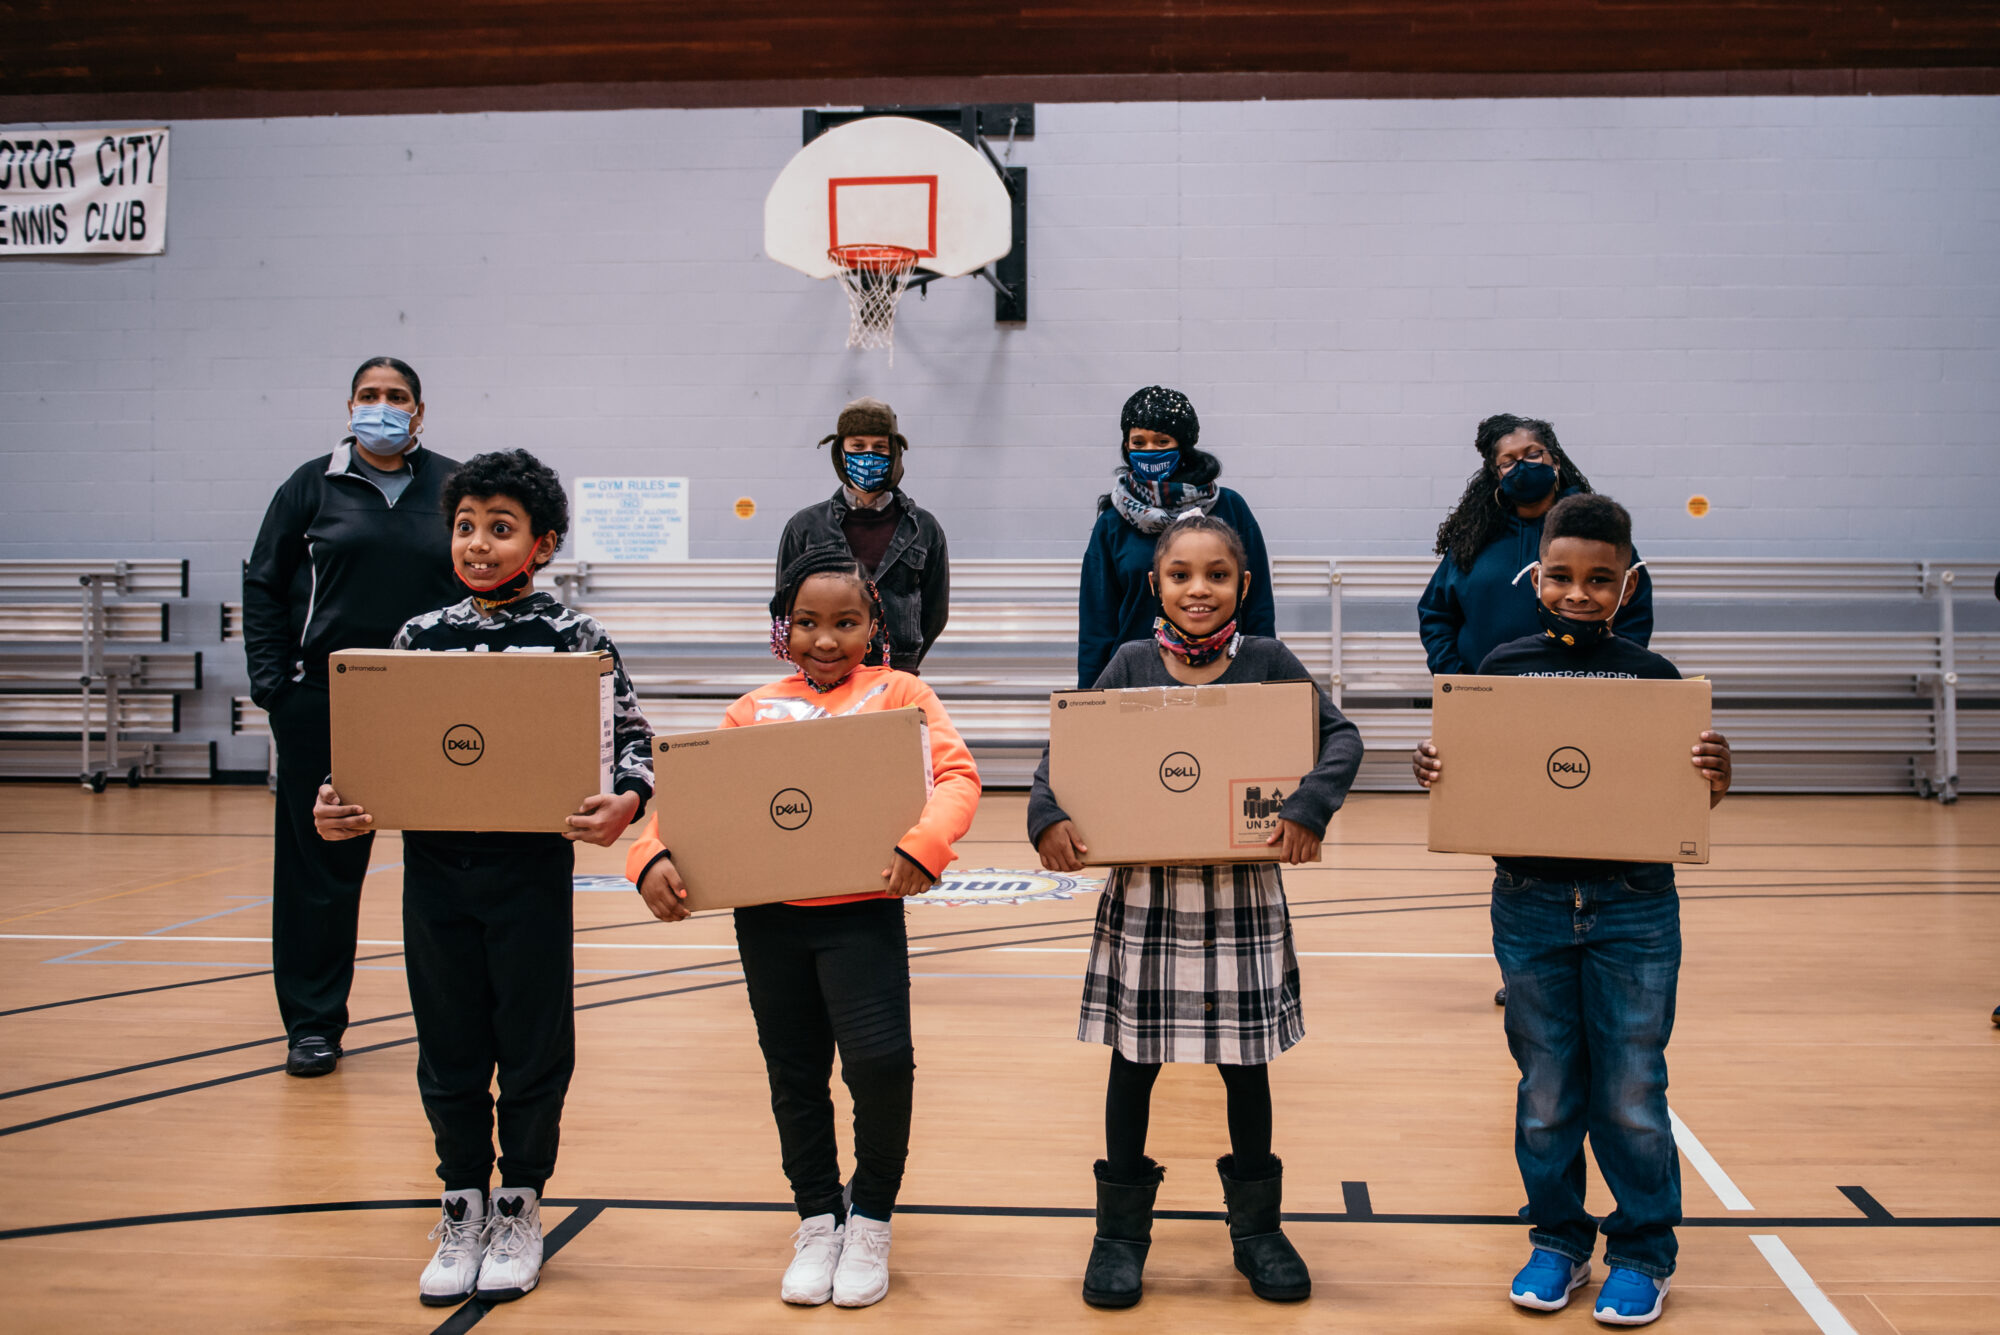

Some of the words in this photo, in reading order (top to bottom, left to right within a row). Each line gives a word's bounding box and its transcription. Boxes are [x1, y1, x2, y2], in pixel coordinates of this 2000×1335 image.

[96, 134, 164, 187] CITY
[85, 200, 146, 243] CLUB
[598, 480, 623, 490] GYM
[628, 480, 665, 490] RULES
[623, 500, 640, 508] NO
[1454, 685, 1494, 693] chromebook
[1069, 699, 1107, 708] chromebook
[448, 739, 480, 751] DELL
[671, 739, 710, 749] chromebook
[1164, 767, 1196, 778] DELL
[1553, 762, 1586, 774] DELL
[775, 803, 808, 816] DELL
[1246, 820, 1262, 830] UN
[1264, 820, 1279, 829] 34
